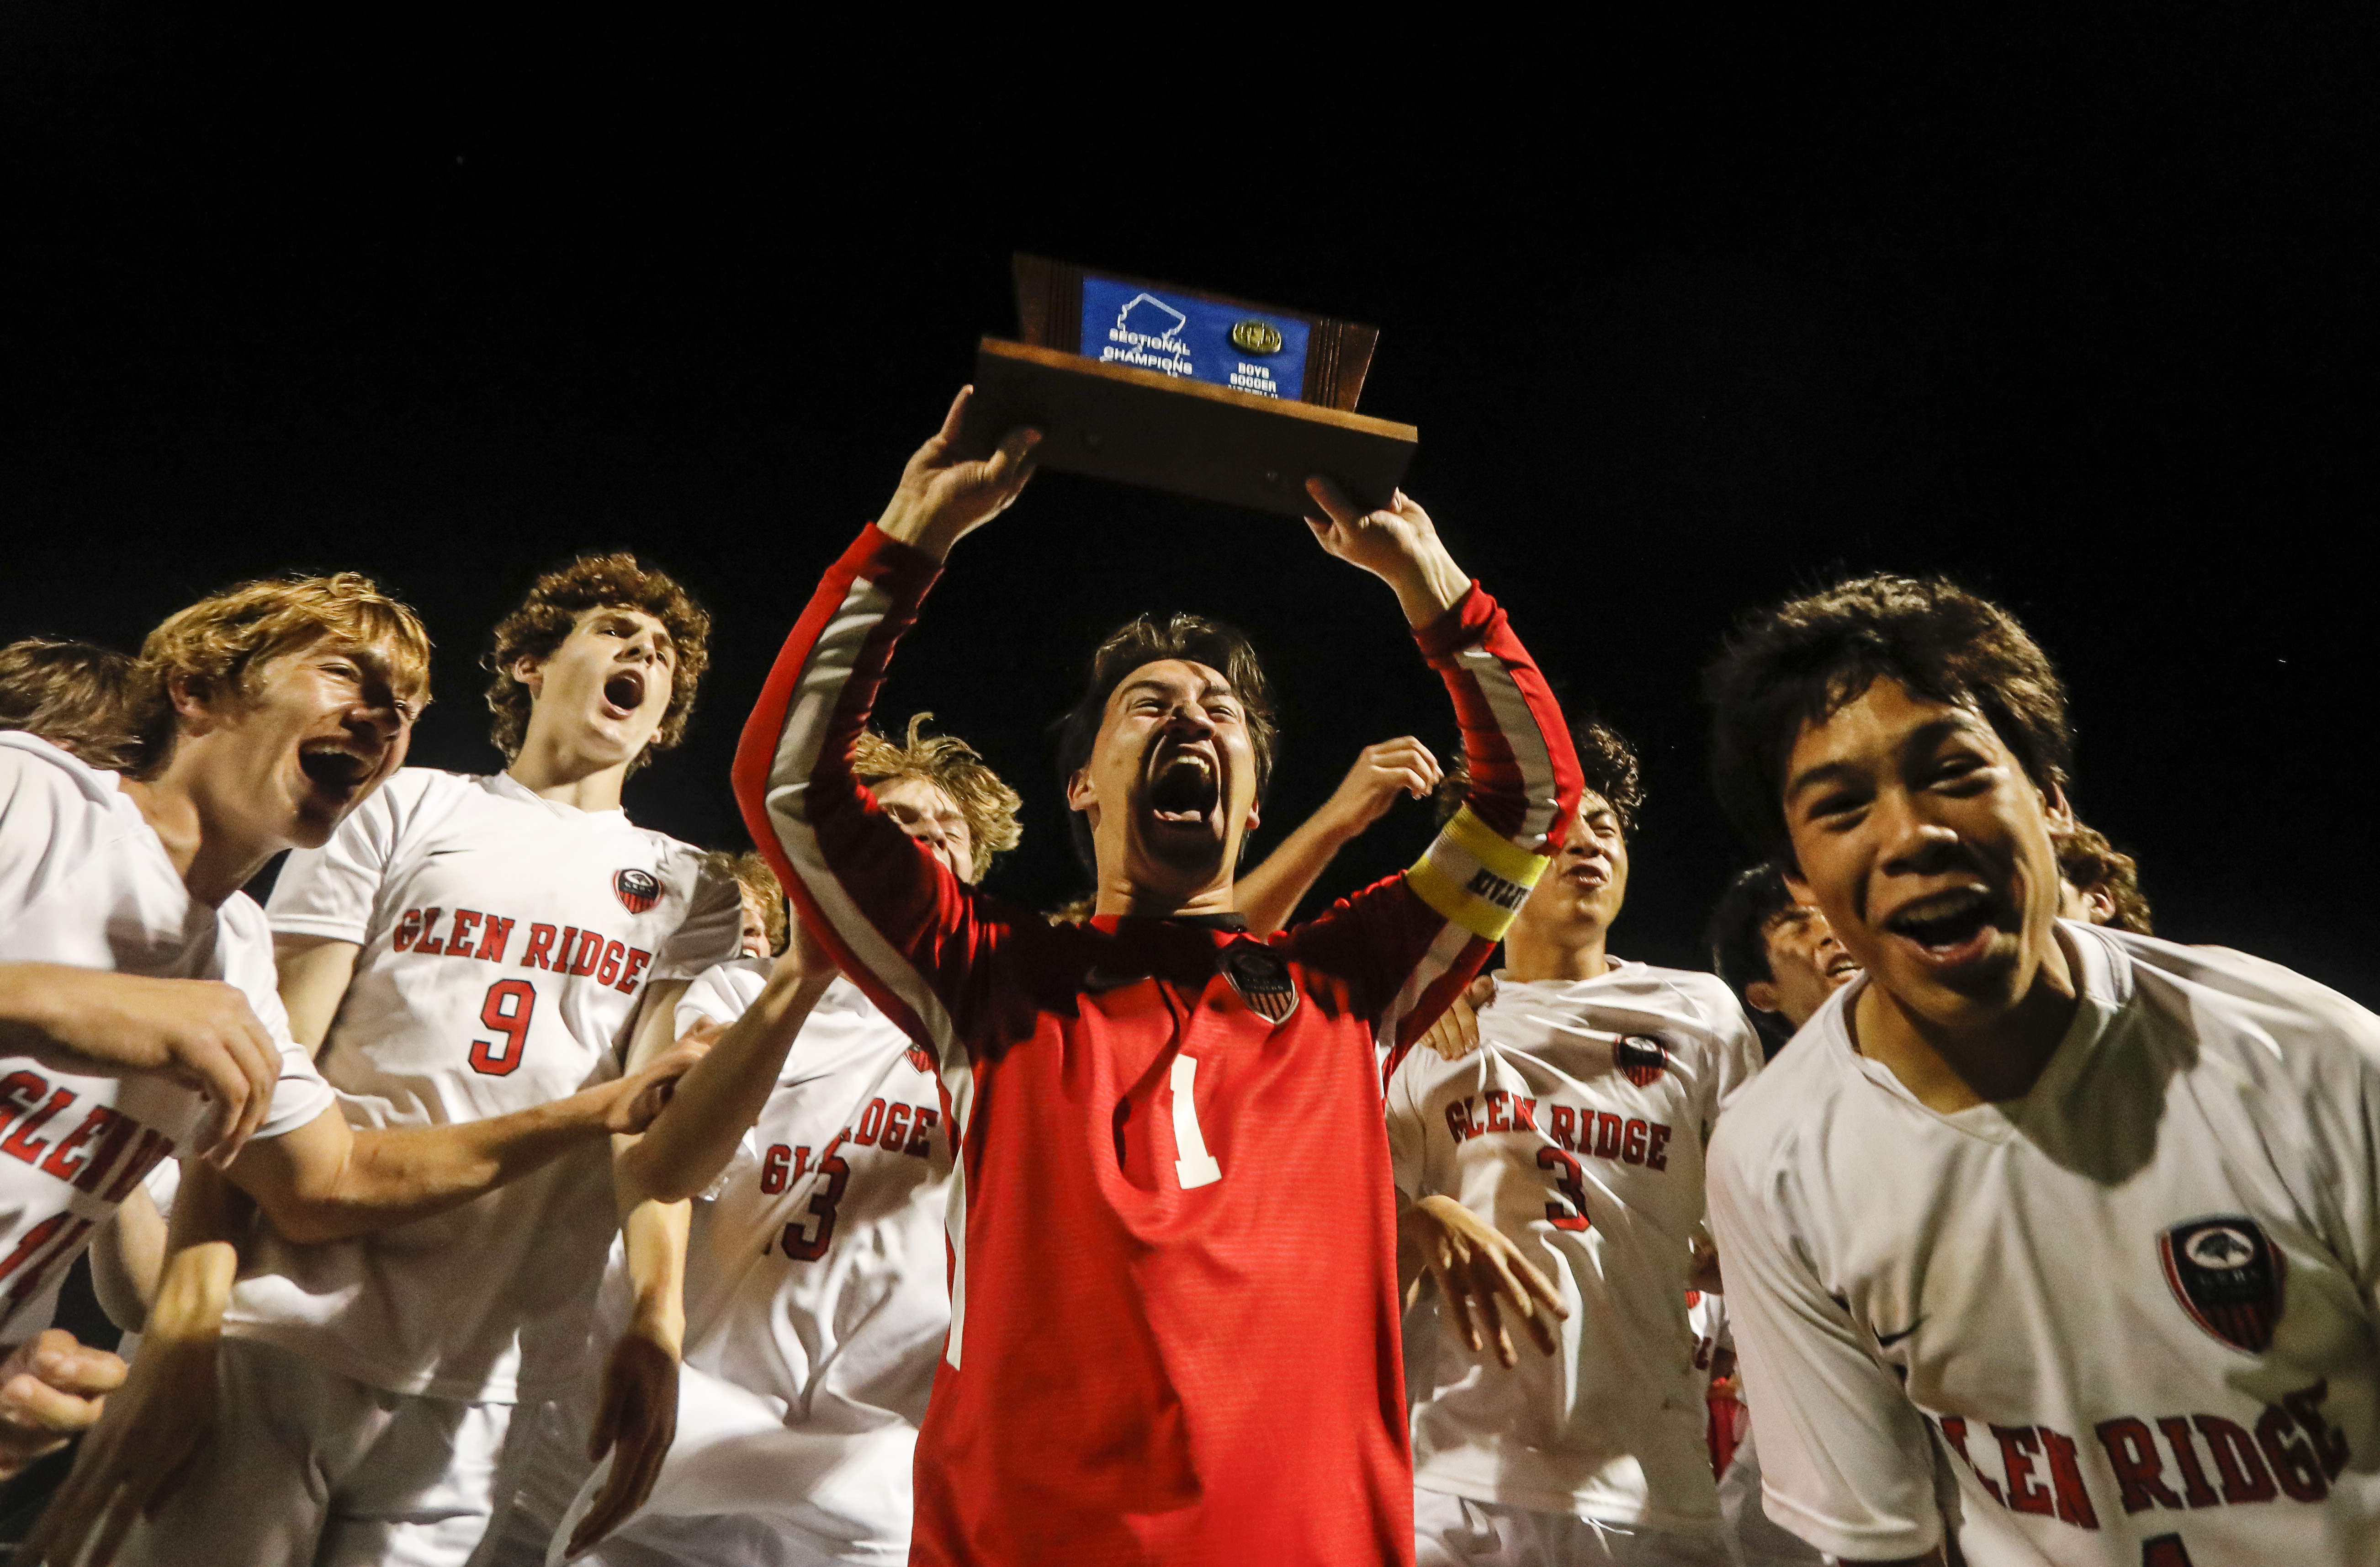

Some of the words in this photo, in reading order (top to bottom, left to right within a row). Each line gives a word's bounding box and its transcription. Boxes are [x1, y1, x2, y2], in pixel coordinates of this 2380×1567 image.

[1103, 345, 1193, 375] CHAMPIONS
[1109, 328, 1190, 356] SECTIONAL
[1230, 372, 1276, 393] SOCCER
[1238, 361, 1269, 379] BOYS
[393, 907, 515, 963] GLEN
[520, 923, 652, 995] RIDGE
[467, 978, 537, 1077] 9
[1170, 1053, 1222, 1190] 1
[1445, 1091, 1538, 1145] GLEN
[1551, 1104, 1671, 1172] RIDGE
[1536, 1145, 1591, 1232] 3
[1940, 1415, 2101, 1531] LEN
[2094, 1377, 2352, 1517] RIDGE
